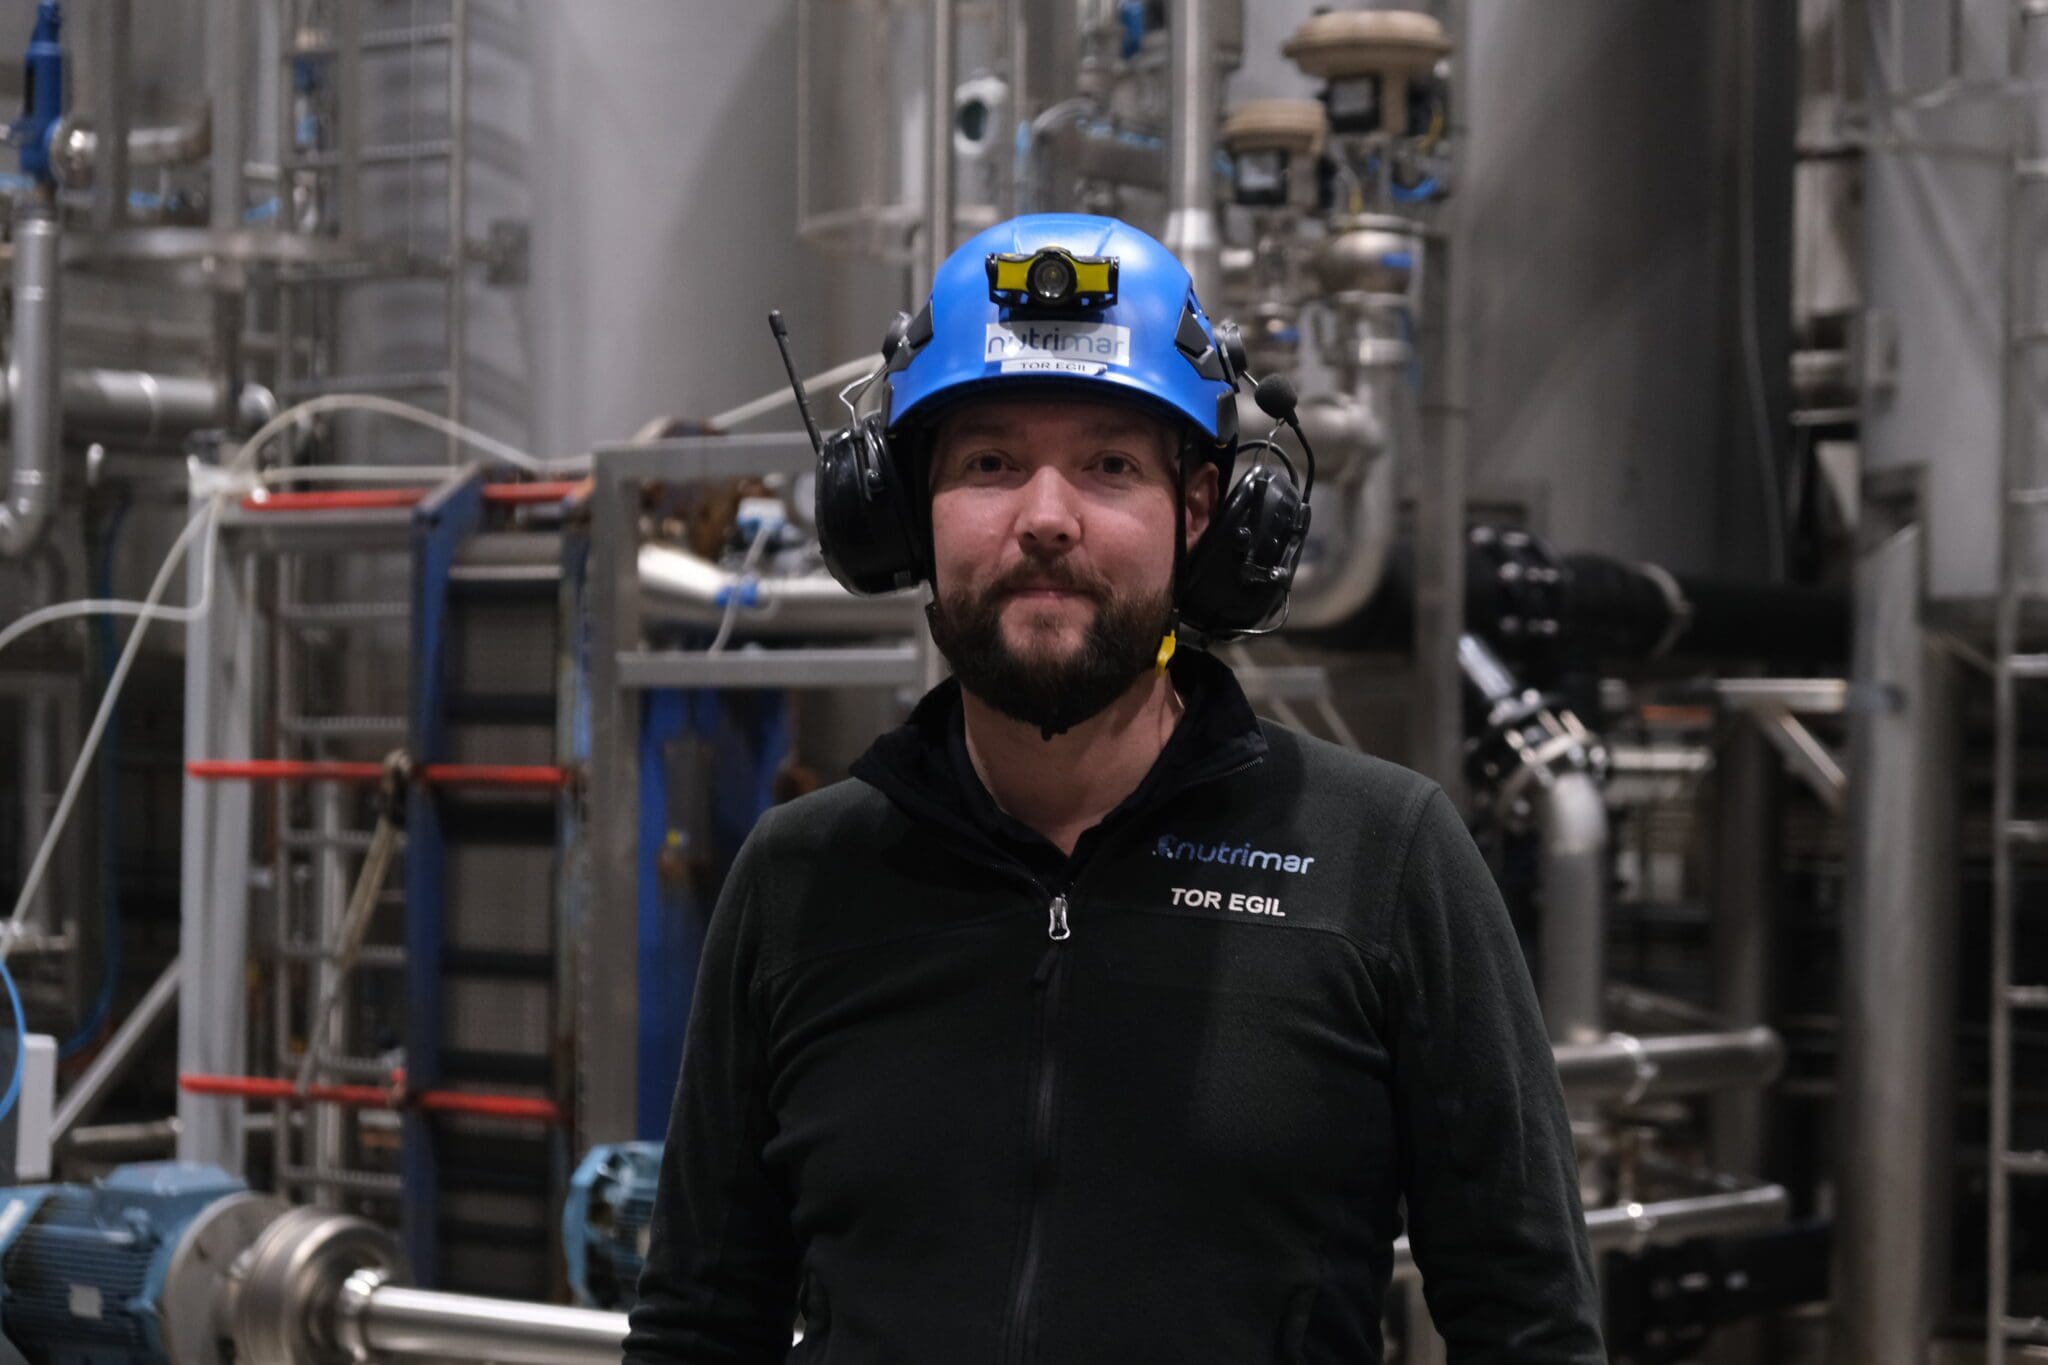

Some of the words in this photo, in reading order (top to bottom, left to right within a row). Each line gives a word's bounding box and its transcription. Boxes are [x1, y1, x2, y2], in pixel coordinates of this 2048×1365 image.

[1020, 361, 1051, 370] TOR
[1175, 841, 1315, 874] nutrimar
[1171, 887, 1222, 910] TOR
[1228, 892, 1286, 917] EGIL
